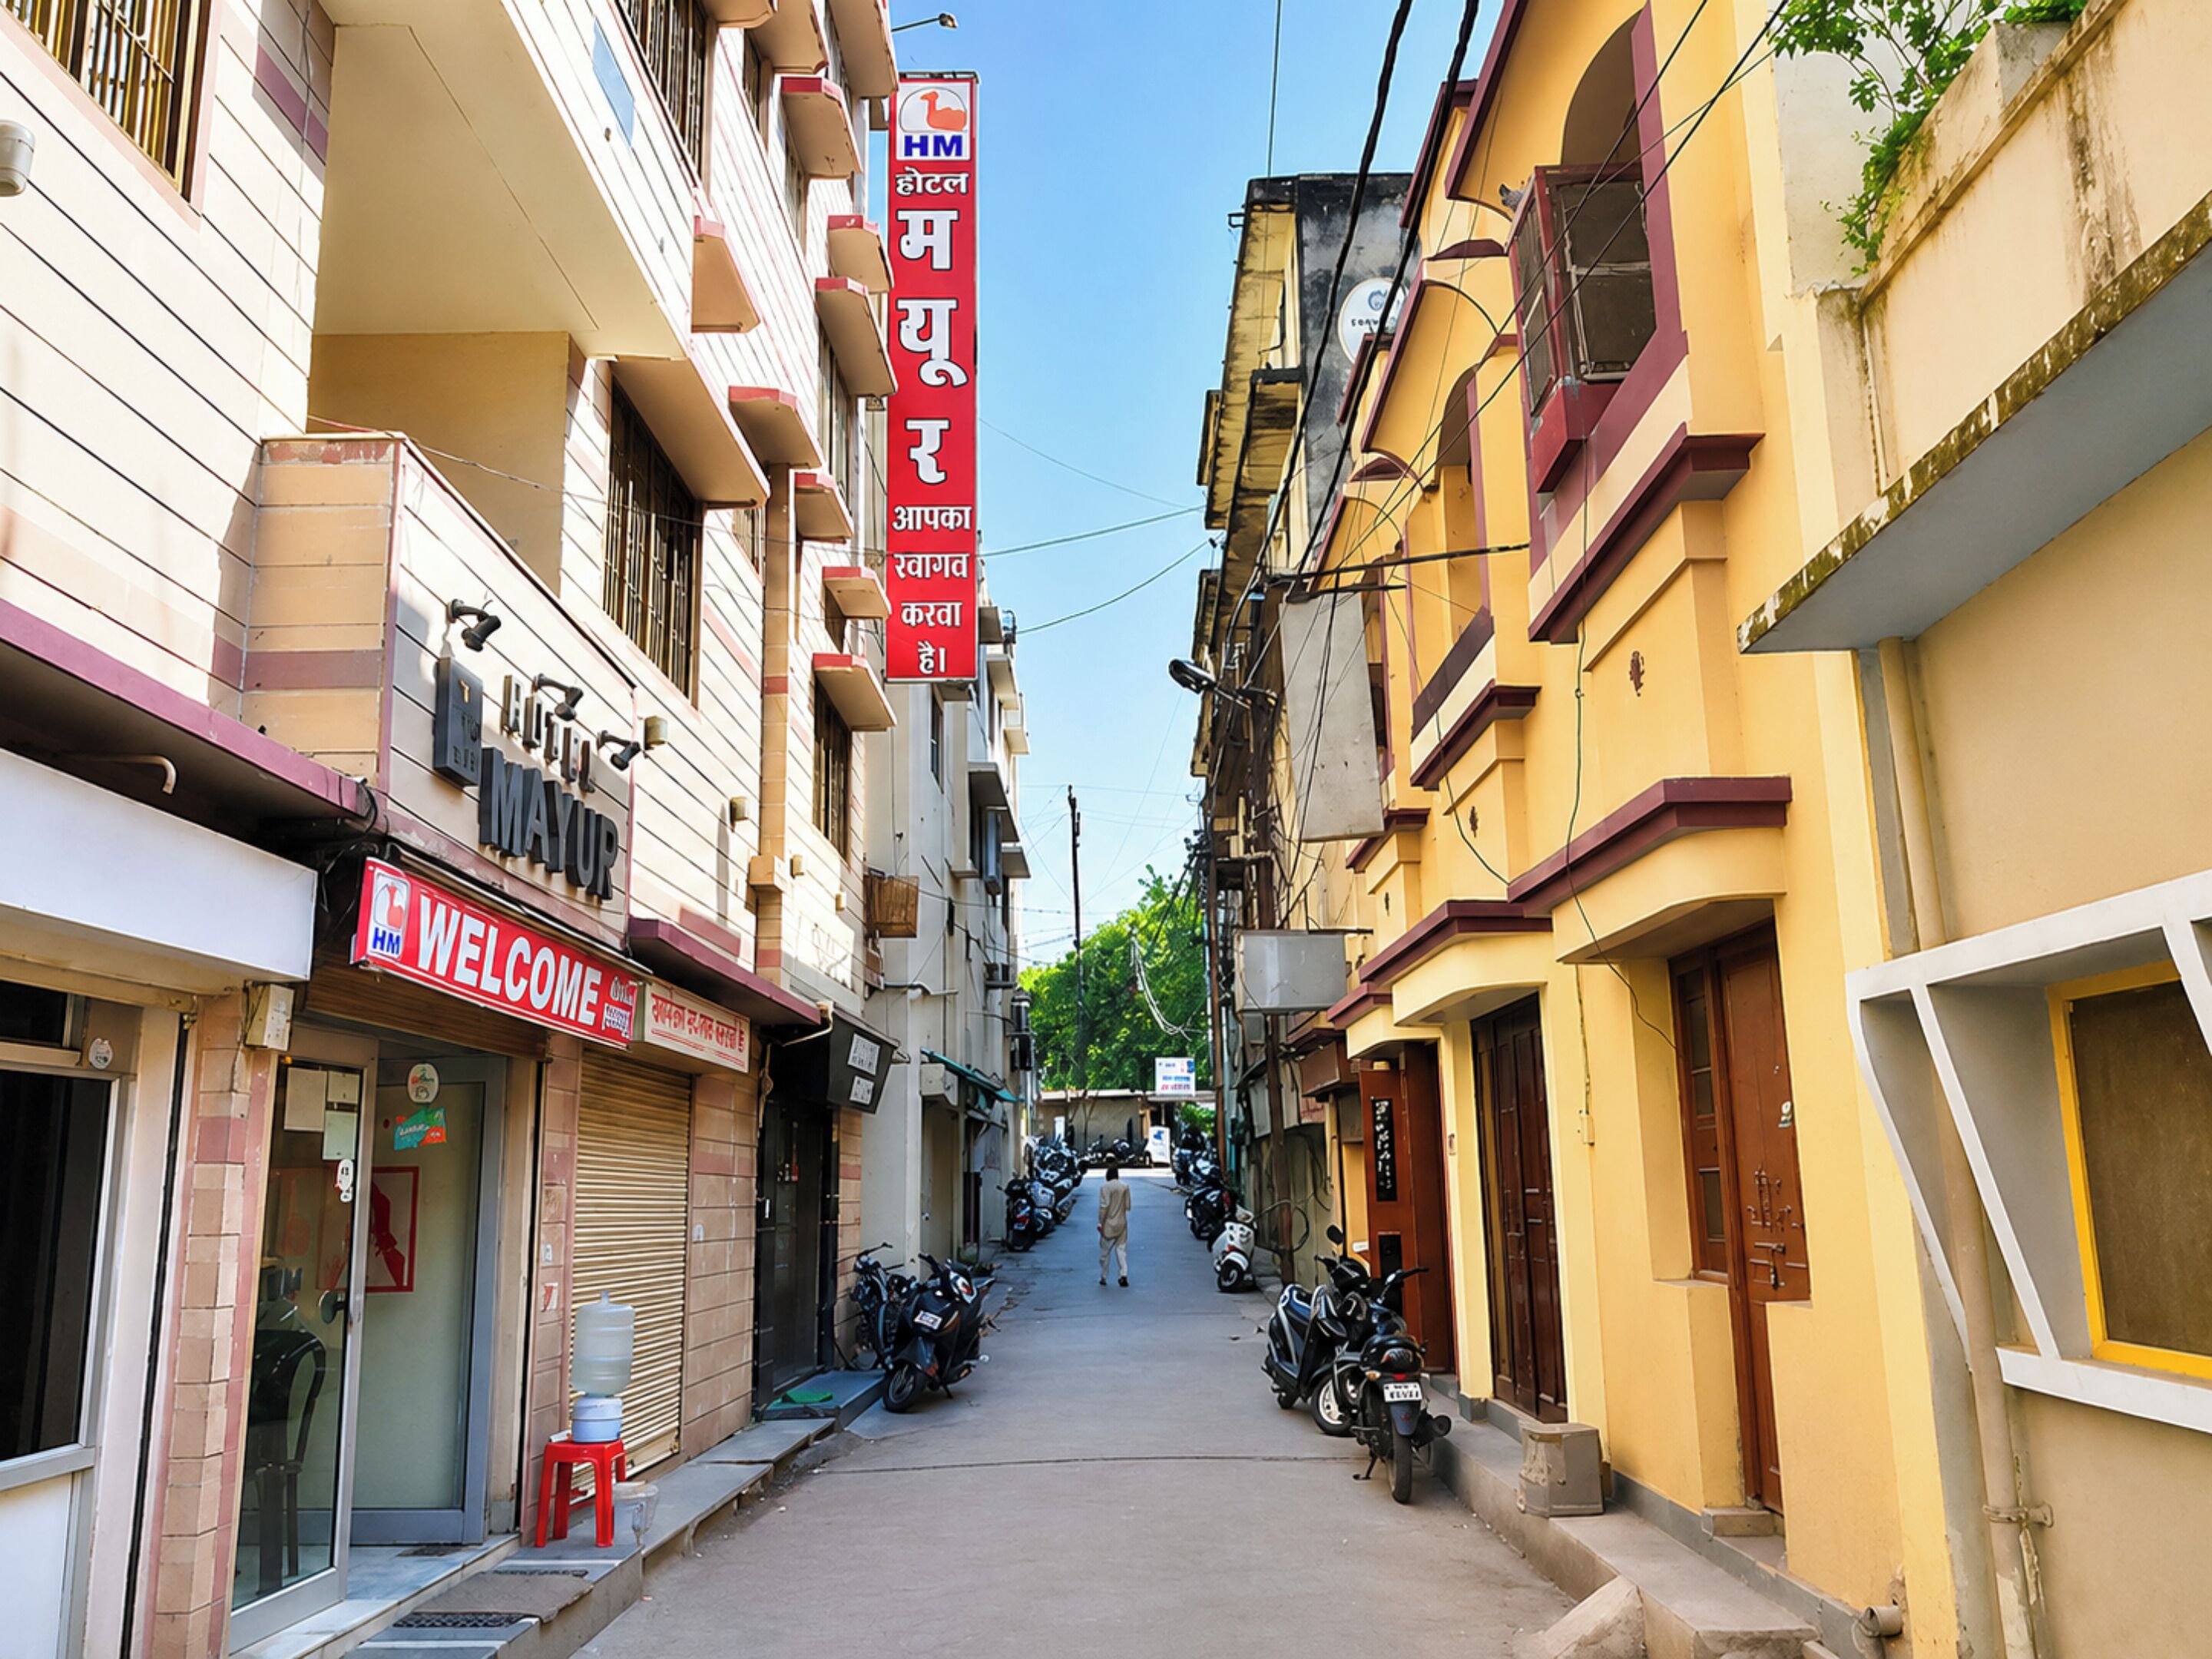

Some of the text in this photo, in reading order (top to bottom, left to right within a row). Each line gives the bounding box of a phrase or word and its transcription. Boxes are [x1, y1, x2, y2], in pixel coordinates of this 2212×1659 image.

[904, 134, 962, 157] HM
[895, 166, 969, 195] होटल
[892, 505, 972, 531] आपका
[478, 747, 618, 900] MAYUR
[373, 926, 401, 955] HM
[417, 893, 602, 1027] WELCOME
